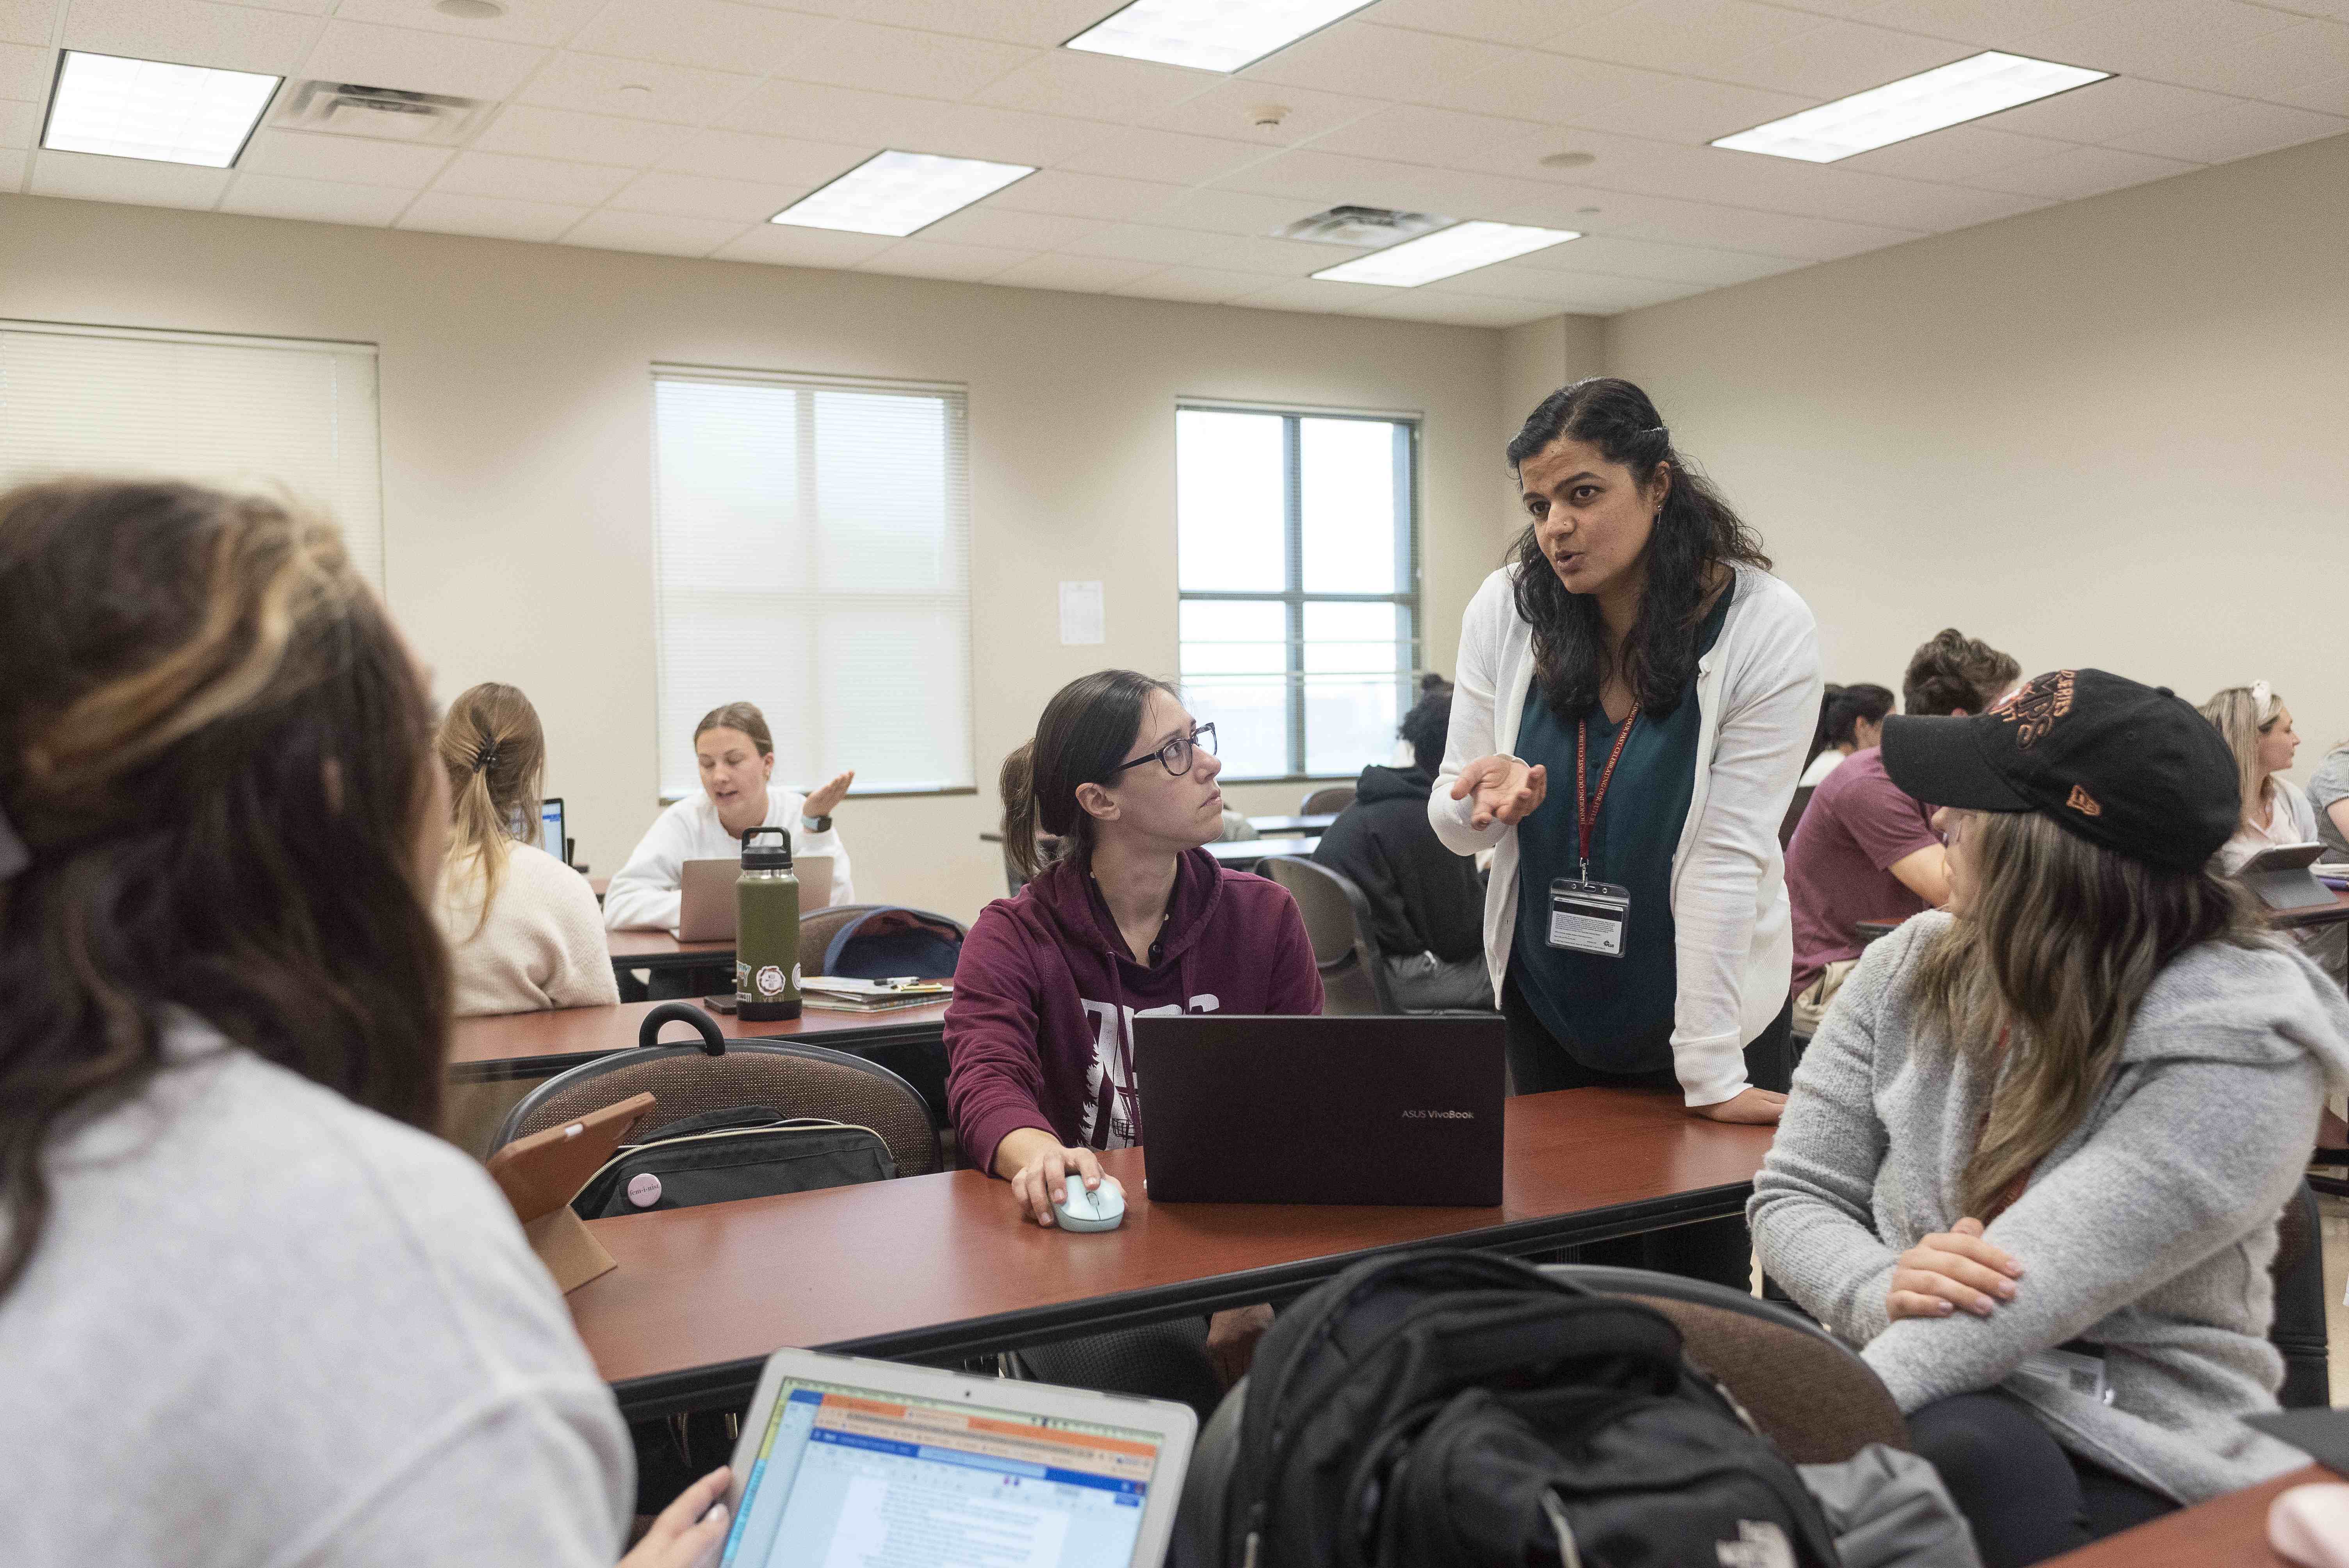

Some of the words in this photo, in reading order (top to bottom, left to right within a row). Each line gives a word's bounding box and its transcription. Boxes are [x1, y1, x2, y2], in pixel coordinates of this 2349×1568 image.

[1624, 718, 1633, 731] OUR
[1601, 747, 1620, 788] CELEBRATING
[1596, 788, 1604, 801] OUR
[1428, 1110, 1474, 1119] VivoBook
